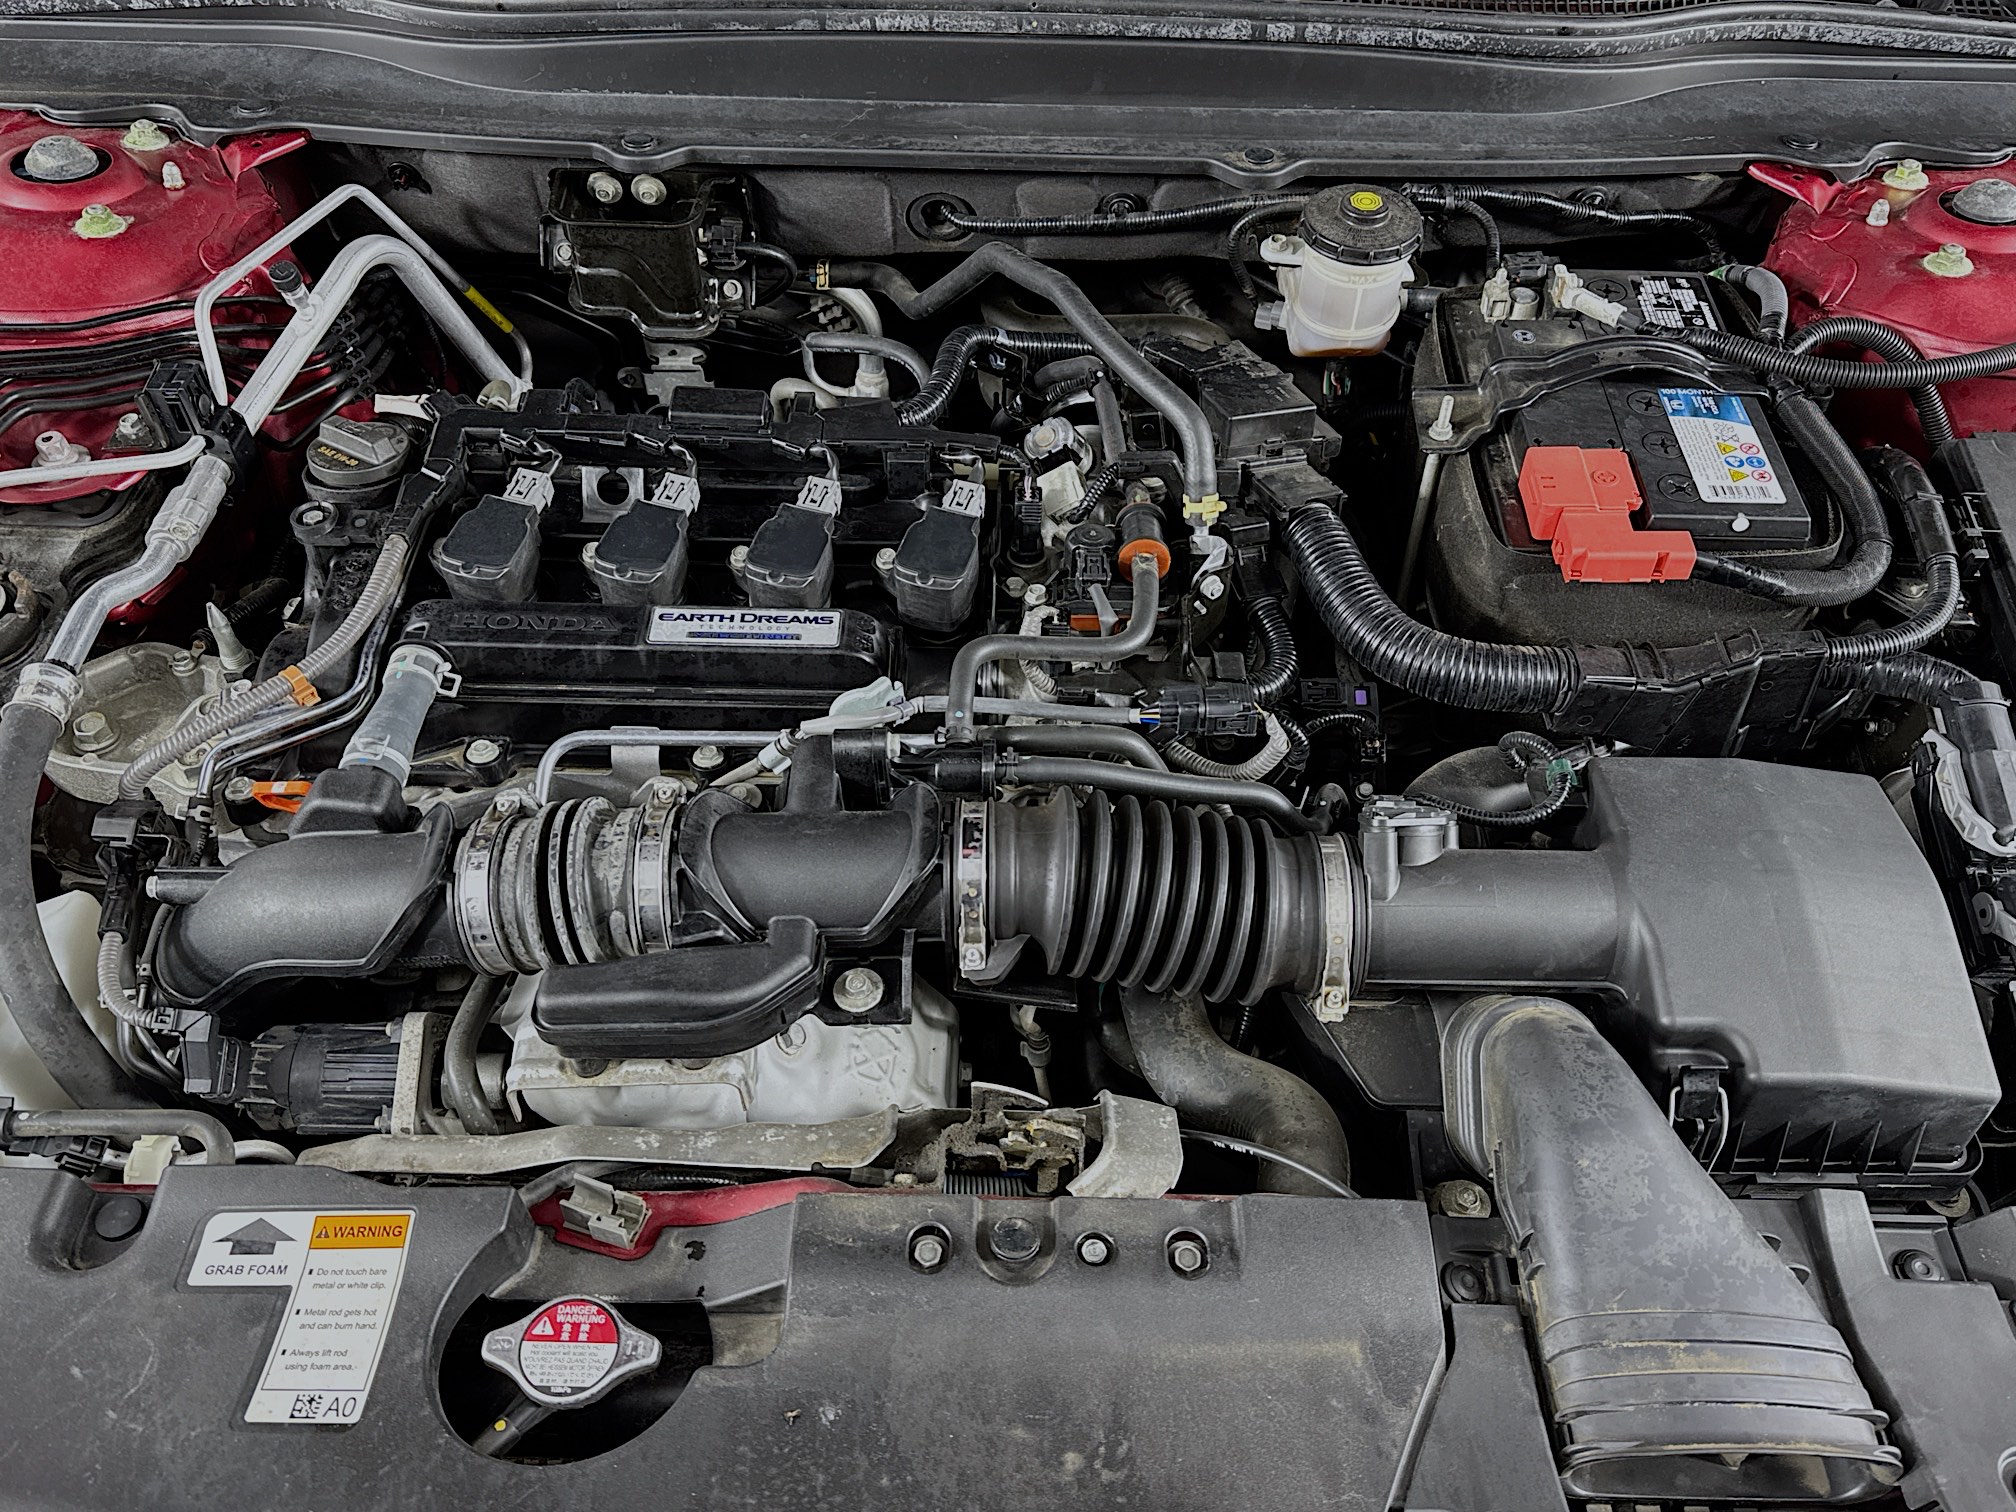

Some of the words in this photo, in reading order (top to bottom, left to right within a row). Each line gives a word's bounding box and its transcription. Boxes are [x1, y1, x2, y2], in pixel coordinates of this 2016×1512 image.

[318, 446, 336, 457] SAE
[334, 452, 358, 466] 0W-20
[452, 612, 621, 632] HONDA
[658, 613, 734, 622] EARTH
[740, 614, 834, 624] DREAMS
[333, 1226, 403, 1238] WARNING
[204, 1265, 244, 1275] GRAB
[248, 1264, 288, 1275] FOAM
[316, 1268, 326, 1276] Do
[328, 1268, 343, 1276] not
[345, 1268, 368, 1276] touch
[370, 1268, 388, 1276] bare
[370, 1282, 386, 1290] clip.
[344, 1309, 362, 1318] gets
[557, 1304, 599, 1314] DANGER
[556, 1314, 606, 1324] WARNUNG
[299, 1322, 316, 1330] and
[354, 1322, 378, 1330] hand.
[289, 1349, 321, 1358] Always
[285, 1362, 308, 1372] using
[309, 1362, 332, 1370] foam
[323, 1397, 357, 1418] A0
